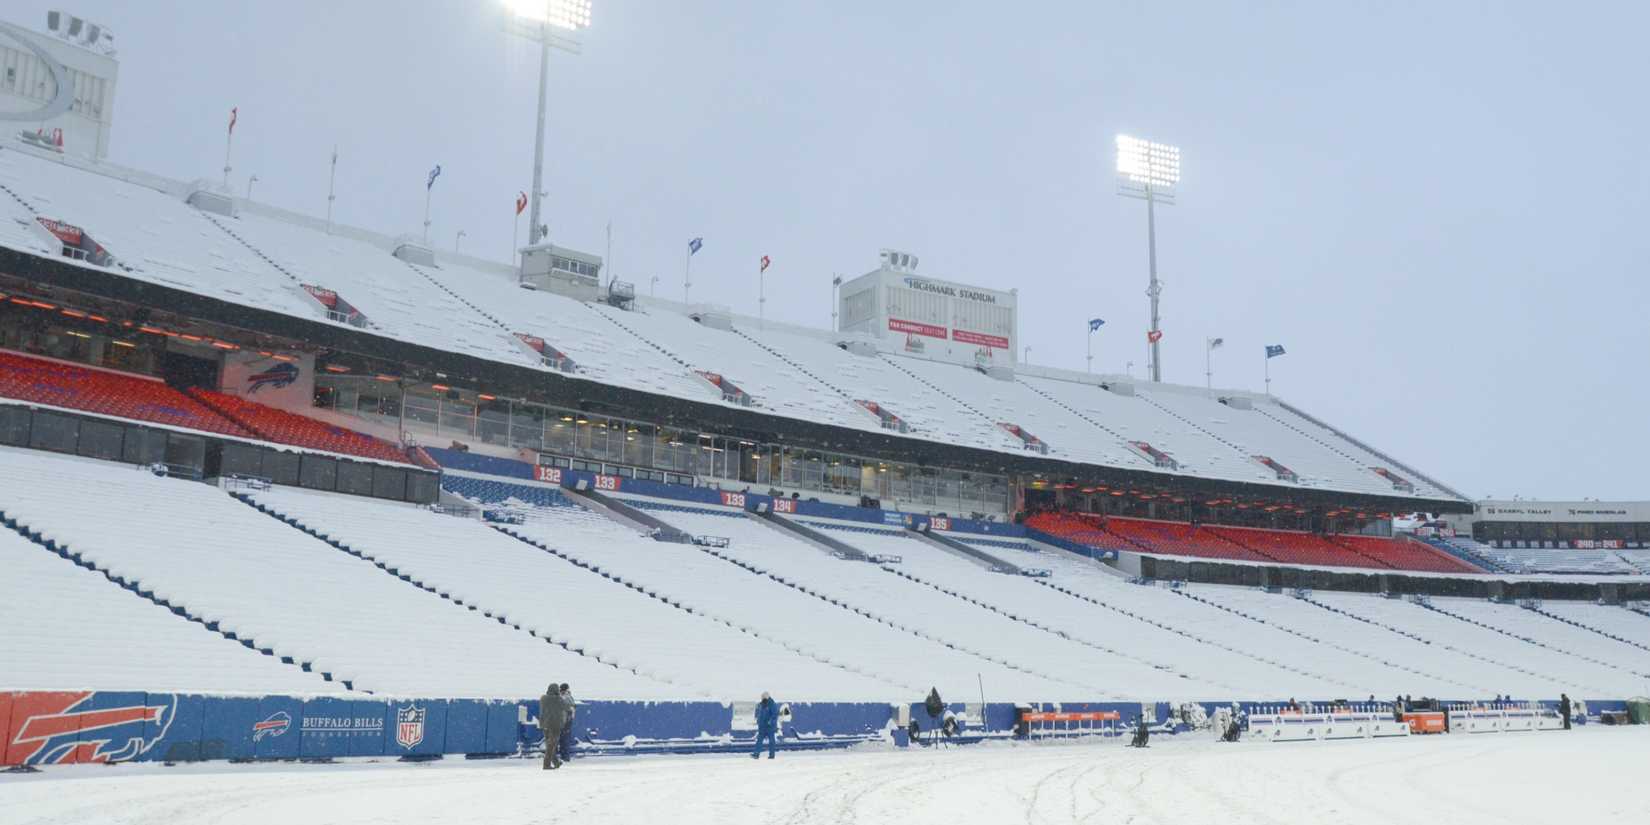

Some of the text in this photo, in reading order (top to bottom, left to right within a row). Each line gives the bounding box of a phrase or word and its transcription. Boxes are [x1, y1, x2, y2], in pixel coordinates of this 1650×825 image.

[909, 280, 996, 304] HIGHMARK STADIUM
[539, 466, 561, 483] 132
[594, 474, 616, 490] 133
[726, 492, 745, 507] 133
[773, 498, 791, 512] 134
[930, 516, 947, 530] 135
[302, 717, 384, 728] BUFFALO BILLS
[399, 723, 421, 743] NFL
